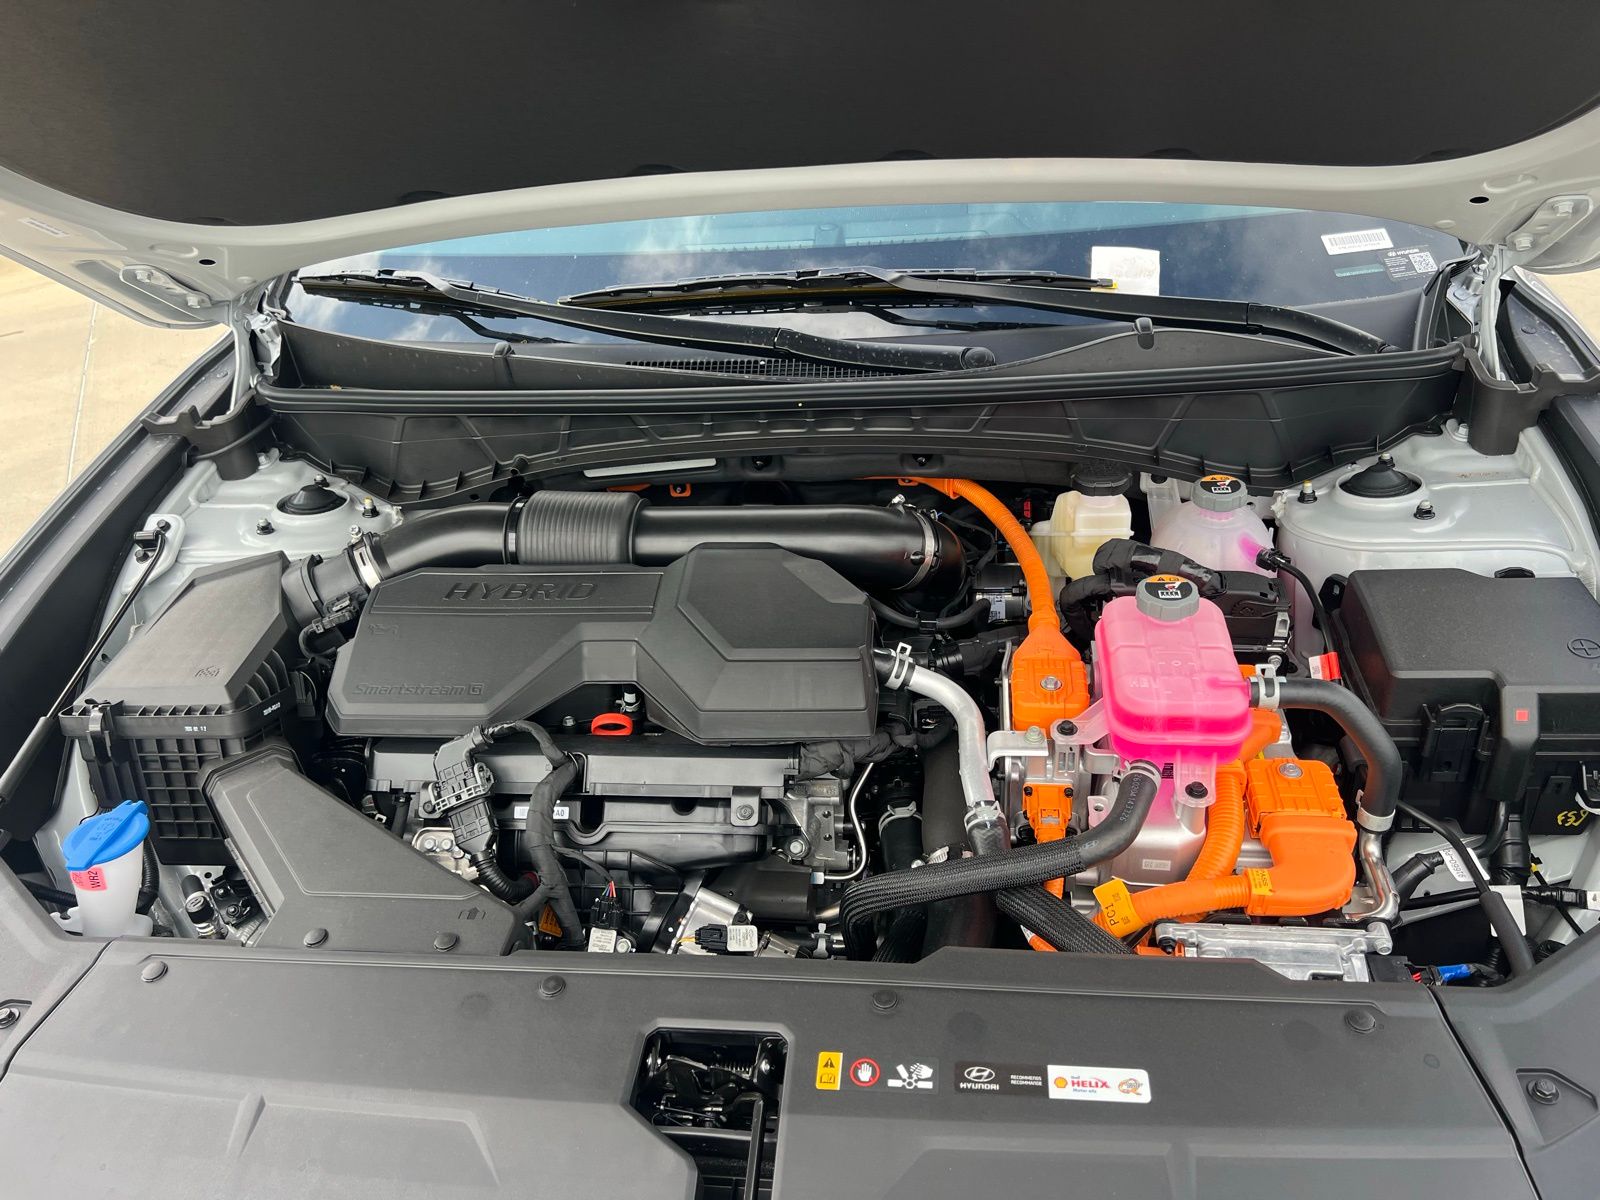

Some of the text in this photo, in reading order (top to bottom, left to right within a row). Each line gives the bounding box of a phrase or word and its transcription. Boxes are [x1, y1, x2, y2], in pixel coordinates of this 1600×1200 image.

[441, 582, 599, 602] HYBRID
[352, 682, 465, 696] Smartstream
[87, 870, 101, 889] WR2
[1105, 902, 1120, 926] PC1
[959, 1082, 1000, 1091] HYUNDAI
[1071, 1079, 1111, 1089] HELIX
